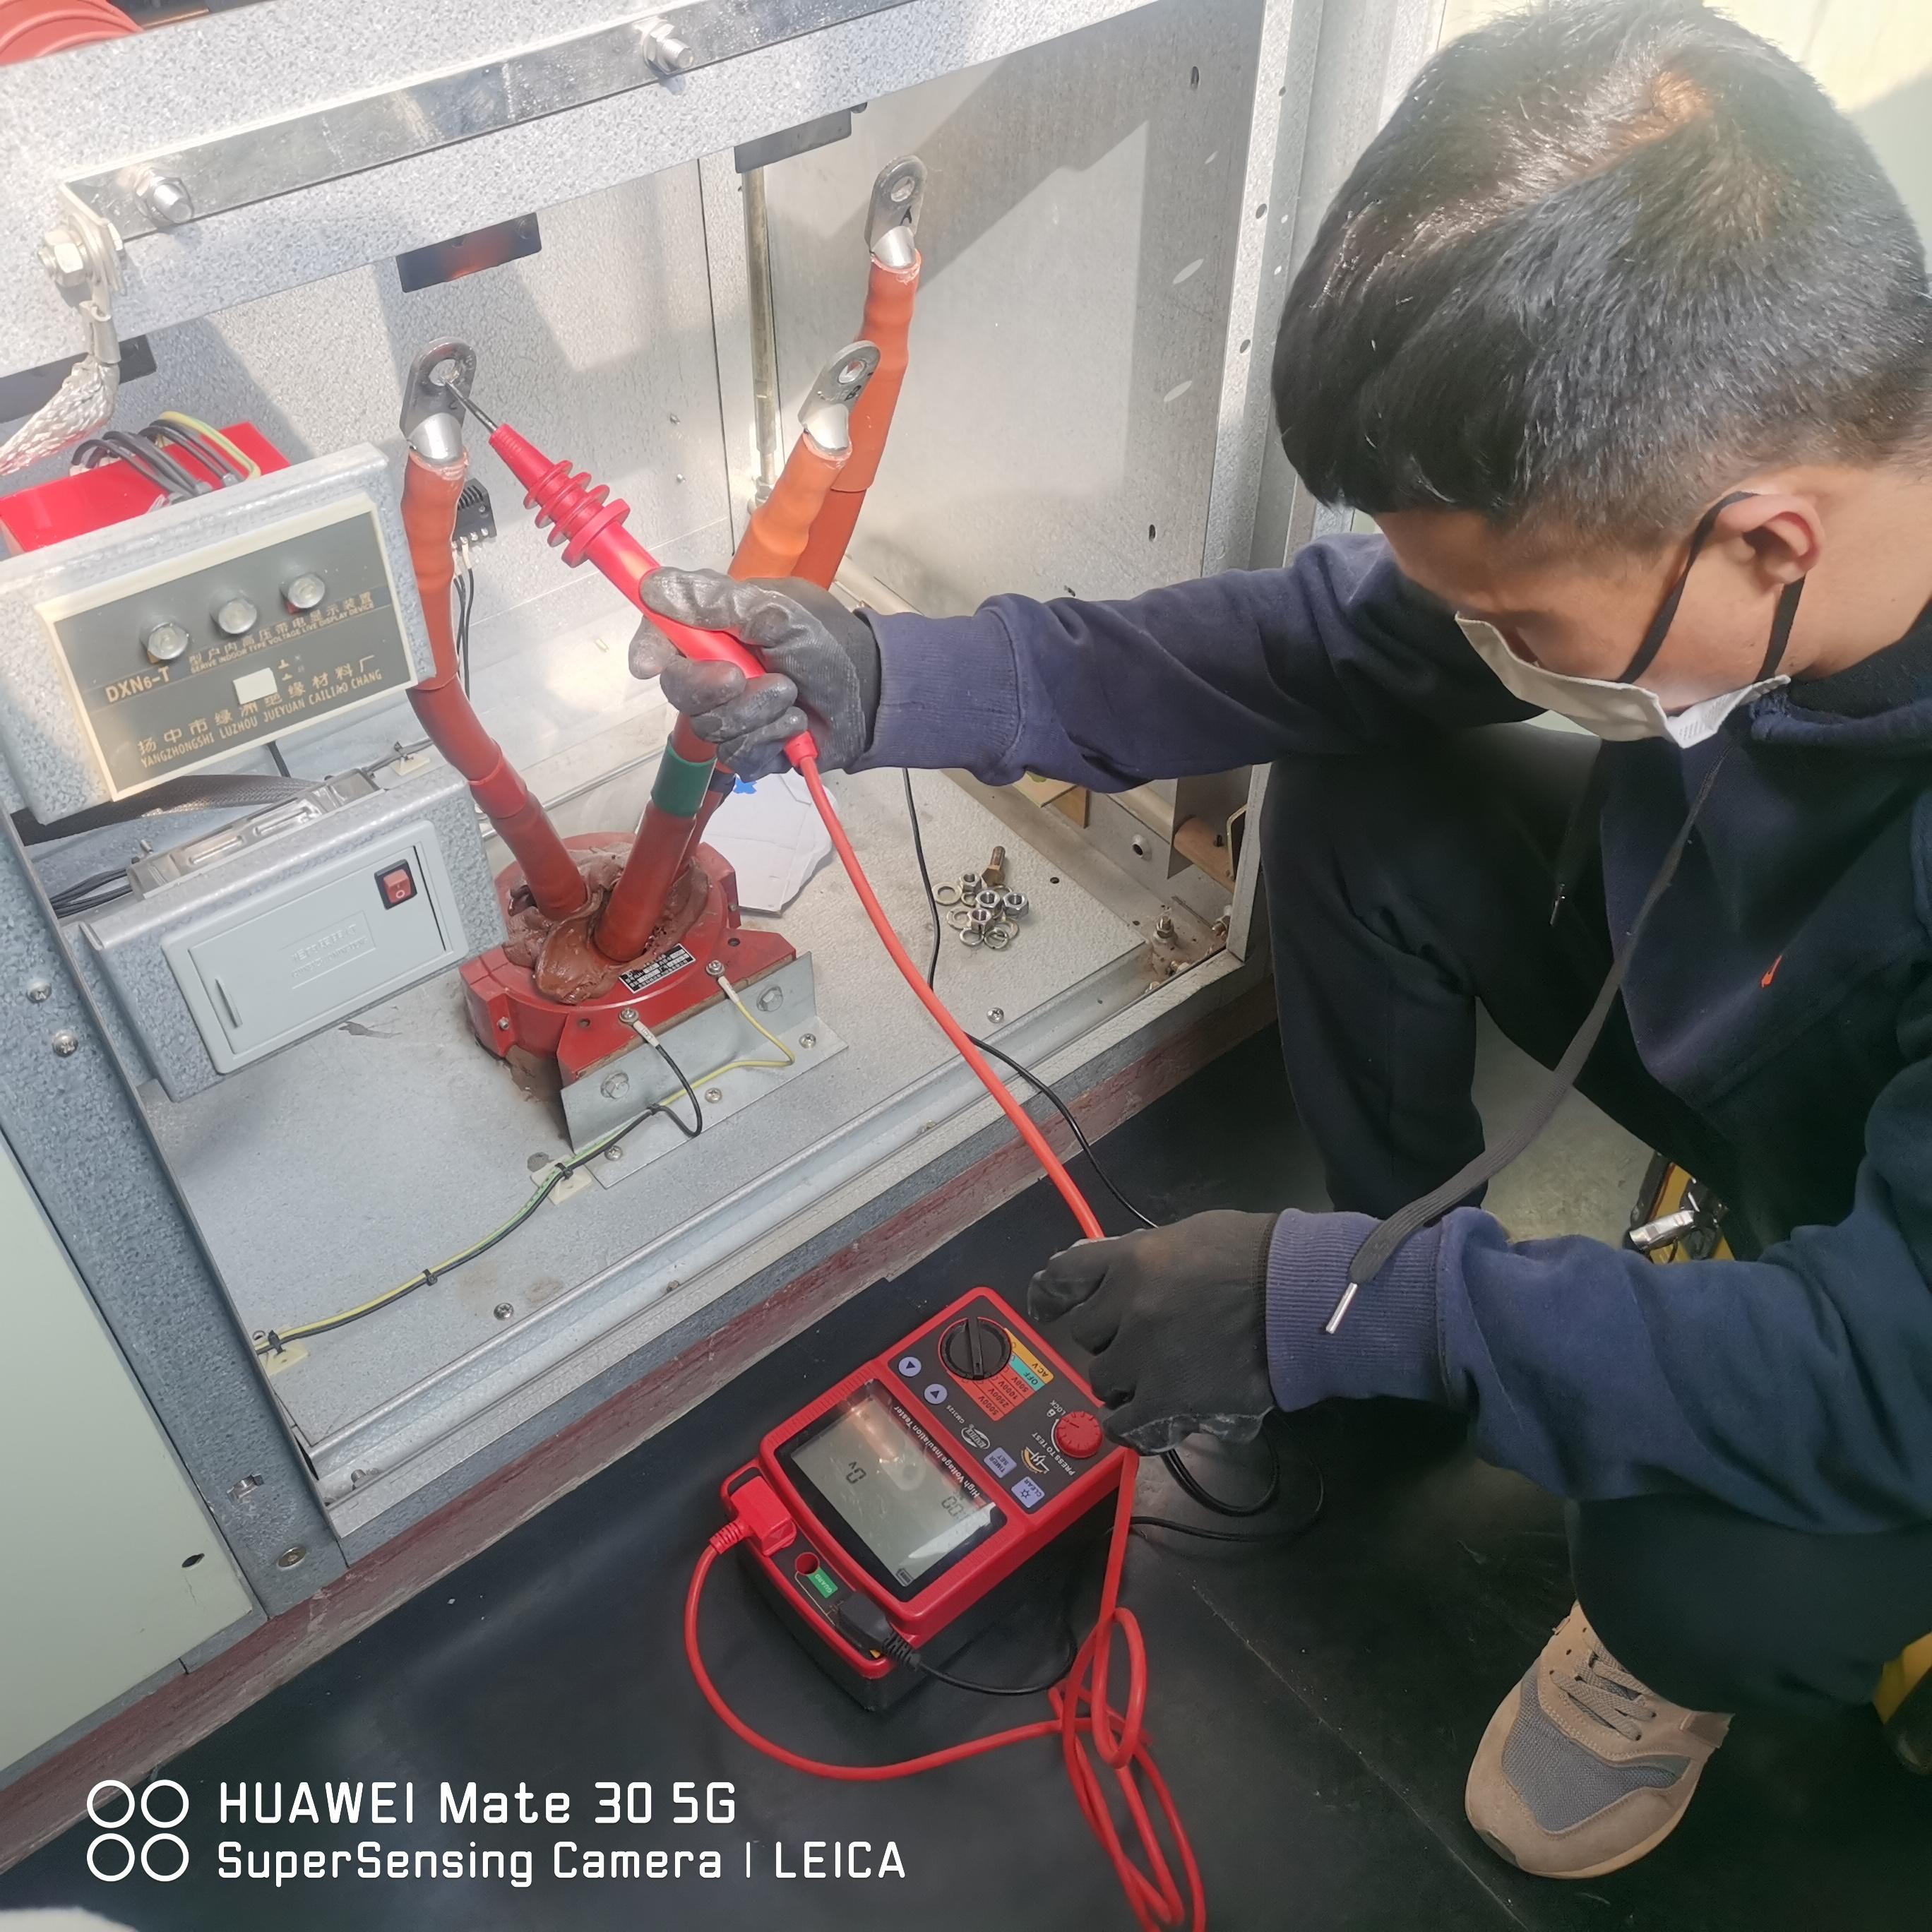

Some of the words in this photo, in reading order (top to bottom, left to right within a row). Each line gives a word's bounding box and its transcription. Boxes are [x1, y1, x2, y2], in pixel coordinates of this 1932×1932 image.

[219, 648, 248, 663] INDOOR
[249, 641, 268, 652] TYPE
[268, 628, 302, 645] VOLTAGE
[302, 622, 318, 633] LIVE
[318, 611, 348, 627] DISPLAY
[348, 602, 375, 616] DEVICE
[105, 666, 169, 703] DXN6-T
[141, 732, 215, 768] YANGZHONGSHI
[219, 716, 258, 739] LUZHOU
[262, 698, 306, 723] JUEYUAN
[309, 681, 349, 705] CAILIAO
[350, 669, 383, 689] CHANG
[1010, 1375, 1028, 1393] 500V
[1022, 1370, 1038, 1385] OFF
[987, 1386, 1008, 1408] 2500V
[997, 1379, 1018, 1400] 1000V
[977, 1394, 998, 1416] 5000V
[1049, 1399, 1066, 1416] LOCK
[891, 1404, 914, 1427] Tester
[911, 1424, 943, 1458] Insulation
[1031, 1431, 1048, 1448] TEST
[997, 1455, 1009, 1466] SET
[1045, 1445, 1056, 1457] TO
[939, 1455, 966, 1482] Voltage
[989, 1455, 1006, 1472] TIMER
[1054, 1454, 1075, 1476] PRESS
[962, 1479, 981, 1498] High
[1023, 1479, 1042, 1497] CLEAR
[813, 1573, 833, 1593] GUARD
